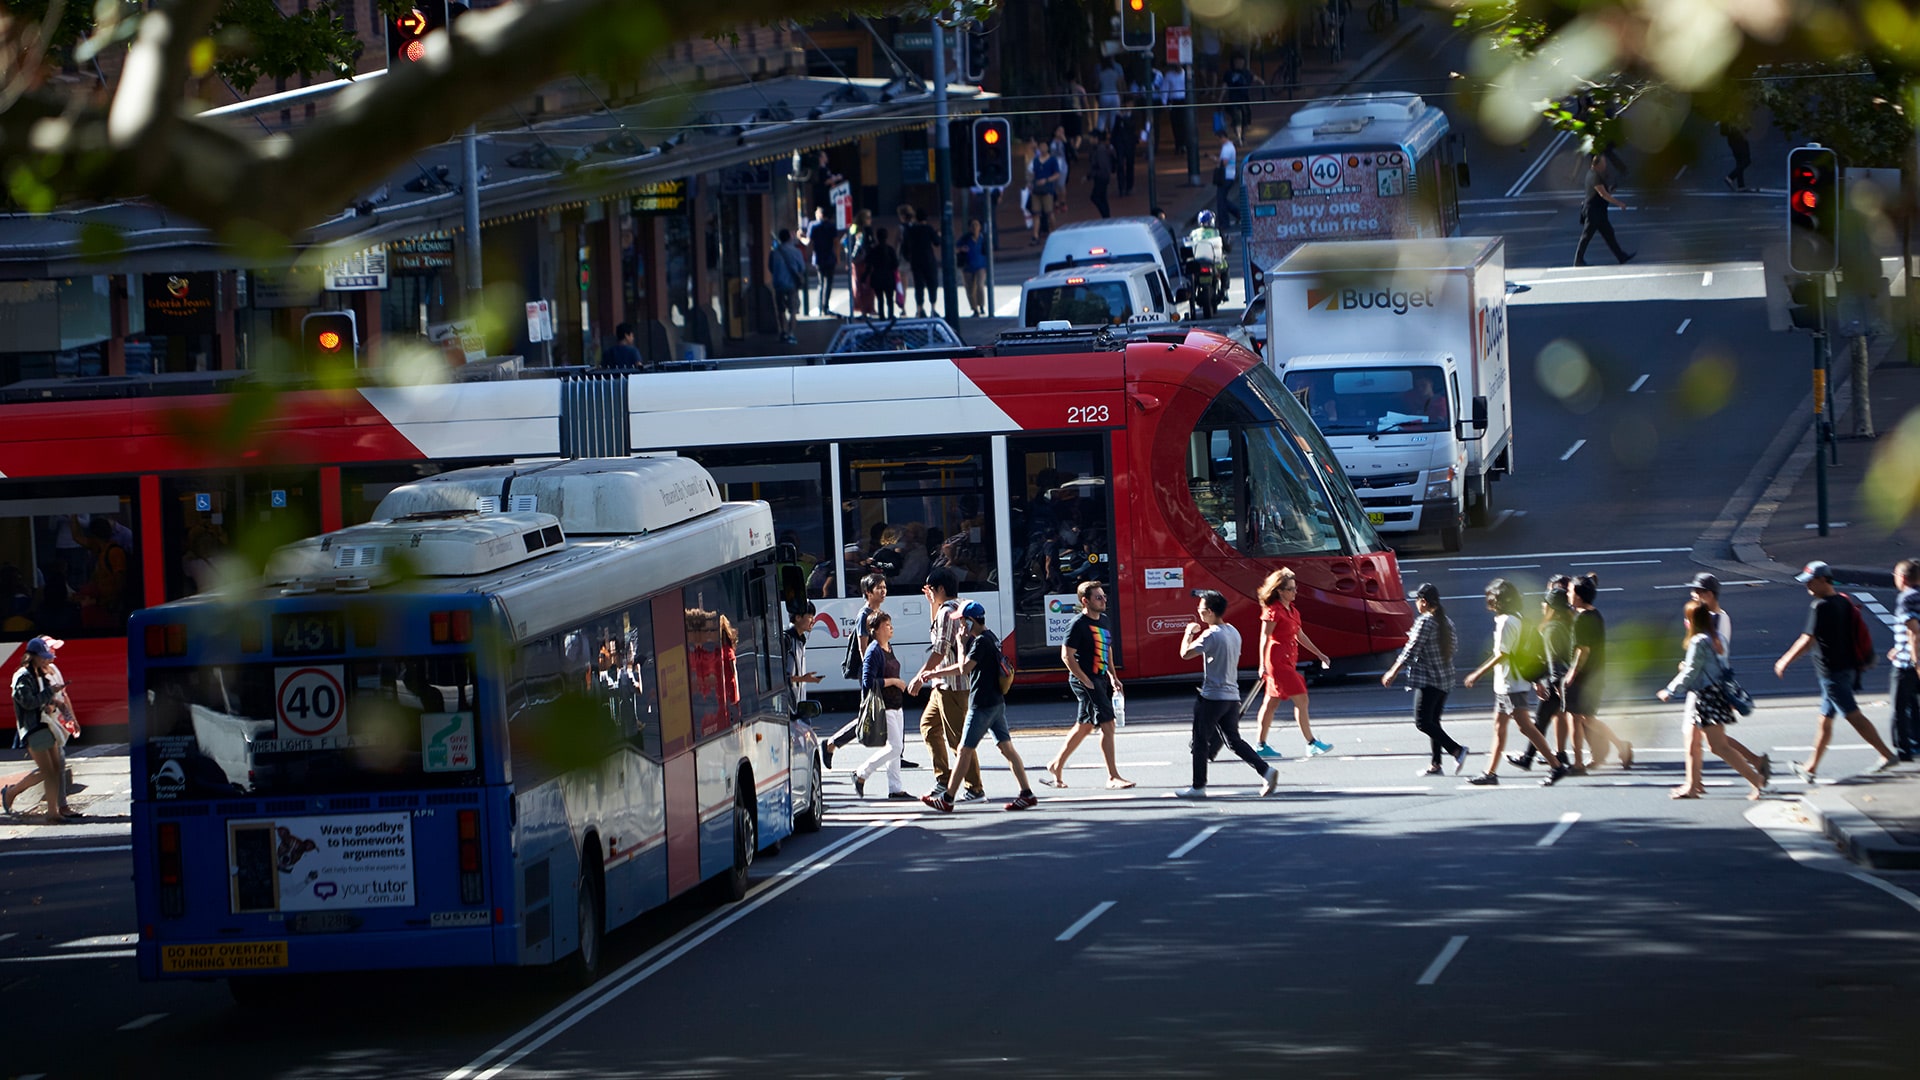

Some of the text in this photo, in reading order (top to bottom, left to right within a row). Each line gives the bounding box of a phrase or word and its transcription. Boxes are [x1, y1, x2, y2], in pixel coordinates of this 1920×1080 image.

[1314, 163, 1338, 180] 40
[633, 196, 685, 210] SUBWAY
[1291, 202, 1361, 219] buy one
[1277, 217, 1379, 237] get fun free
[423, 254, 452, 267] Town
[148, 298, 181, 308] Gloria
[1343, 288, 1435, 315] Budget
[1135, 314, 1160, 322] TAXI
[1067, 405, 1110, 424] 2123
[840, 617, 856, 626] Tra
[283, 616, 341, 651] 431
[286, 685, 336, 718] 40
[249, 742, 277, 752] WHEN
[280, 739, 314, 751] LIGHTS
[414, 809, 434, 817] APN
[320, 822, 404, 836] Wave goodbye
[328, 835, 404, 847] to homework
[343, 849, 405, 861] arguments
[333, 866, 348, 874] help
[365, 894, 406, 904] .com.au
[433, 911, 488, 921] CUSTOM
[168, 943, 283, 958] DO NOT OVERTAKE
[171, 956, 281, 969] TURNING VEHICLE
